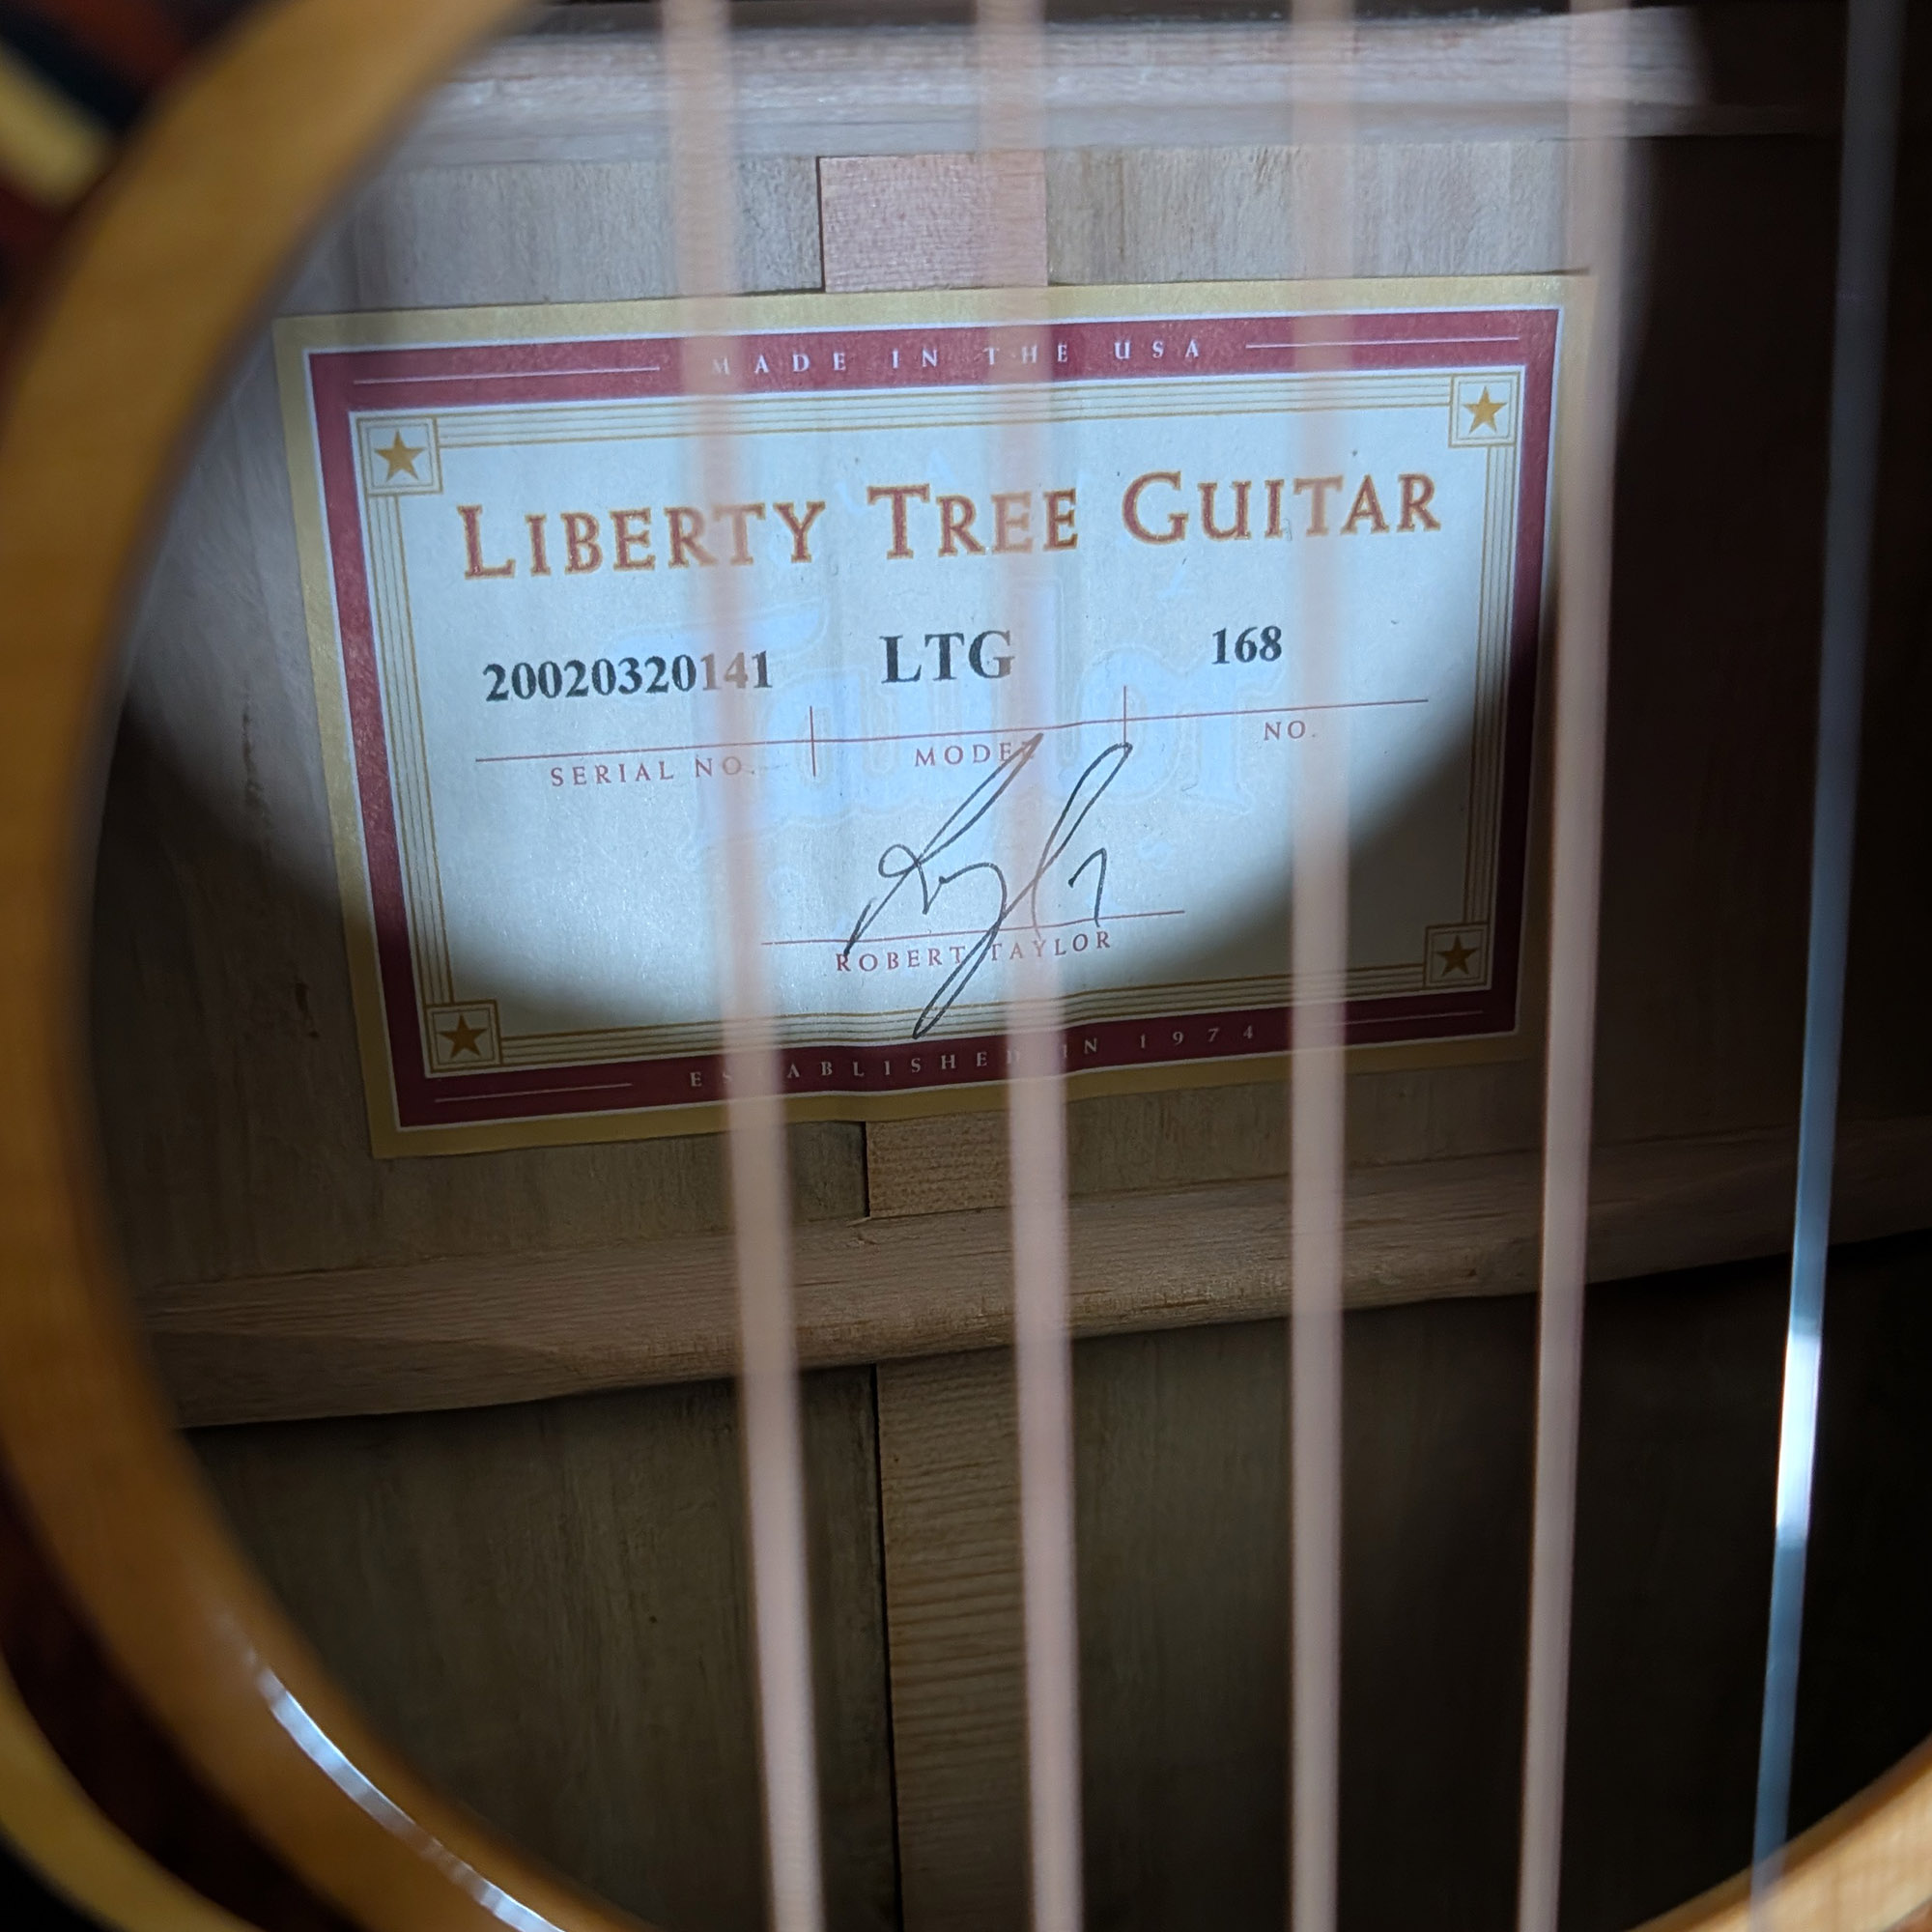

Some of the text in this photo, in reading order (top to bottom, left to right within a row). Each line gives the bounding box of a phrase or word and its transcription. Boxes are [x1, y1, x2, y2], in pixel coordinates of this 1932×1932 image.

[711, 338, 1201, 375] MADE IN THE USA
[879, 630, 1015, 685] LTG
[1211, 625, 1283, 666] 168
[482, 649, 775, 702] 20020320141
[1263, 719, 1317, 741] NO.
[549, 754, 756, 788] SERIAL NO.
[835, 929, 1111, 972] ROBERT TAYLOR
[1139, 1024, 1255, 1050] 1974
